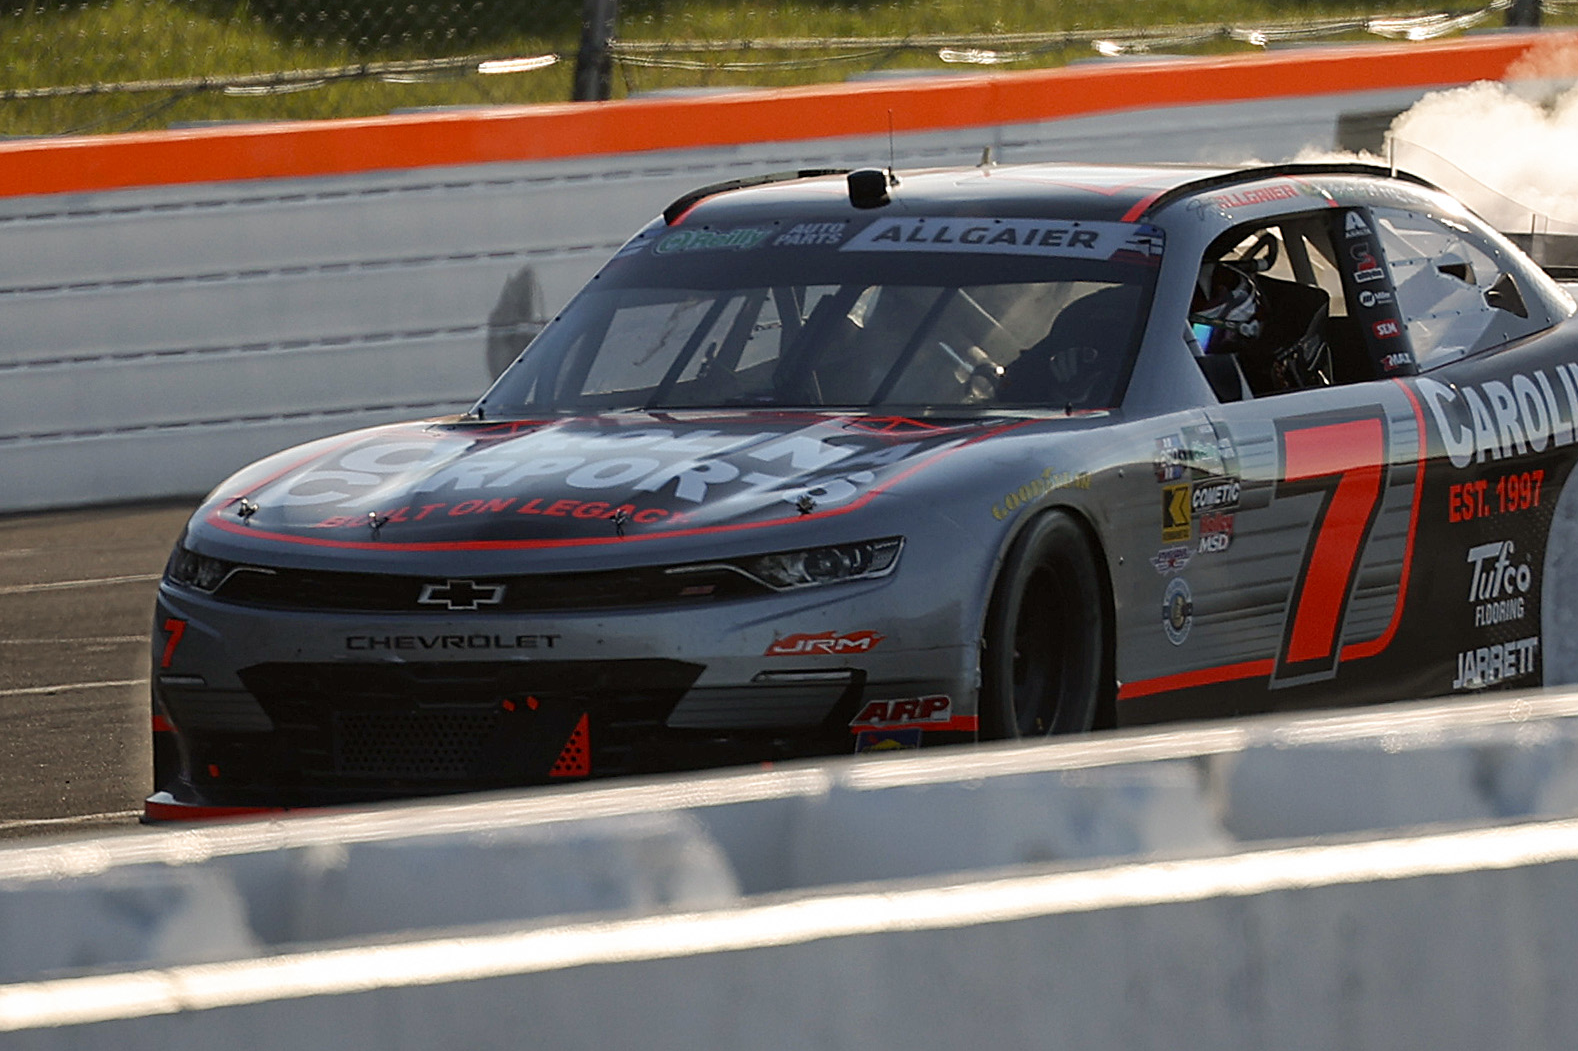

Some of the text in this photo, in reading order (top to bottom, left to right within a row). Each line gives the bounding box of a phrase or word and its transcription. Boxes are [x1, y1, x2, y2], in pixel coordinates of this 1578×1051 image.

[772, 234, 843, 246] PARTS
[791, 223, 846, 234] AUTO
[872, 225, 1099, 249] ALLGAIER
[1376, 322, 1398, 336] SEM
[1192, 483, 1241, 508] COMETIC
[1449, 469, 1545, 523] EST. 1997
[314, 497, 698, 530] BUILT ON LEGACY
[1198, 533, 1230, 554] MSD
[1284, 418, 1384, 664] 7
[1467, 540, 1531, 602] Tufco
[1475, 597, 1525, 628] FLOORING
[160, 619, 187, 668] 7
[346, 634, 562, 650] CHEVROLET
[772, 638, 872, 654] JRM
[1452, 637, 1539, 690] JARRETT
[854, 696, 950, 724] ARP
